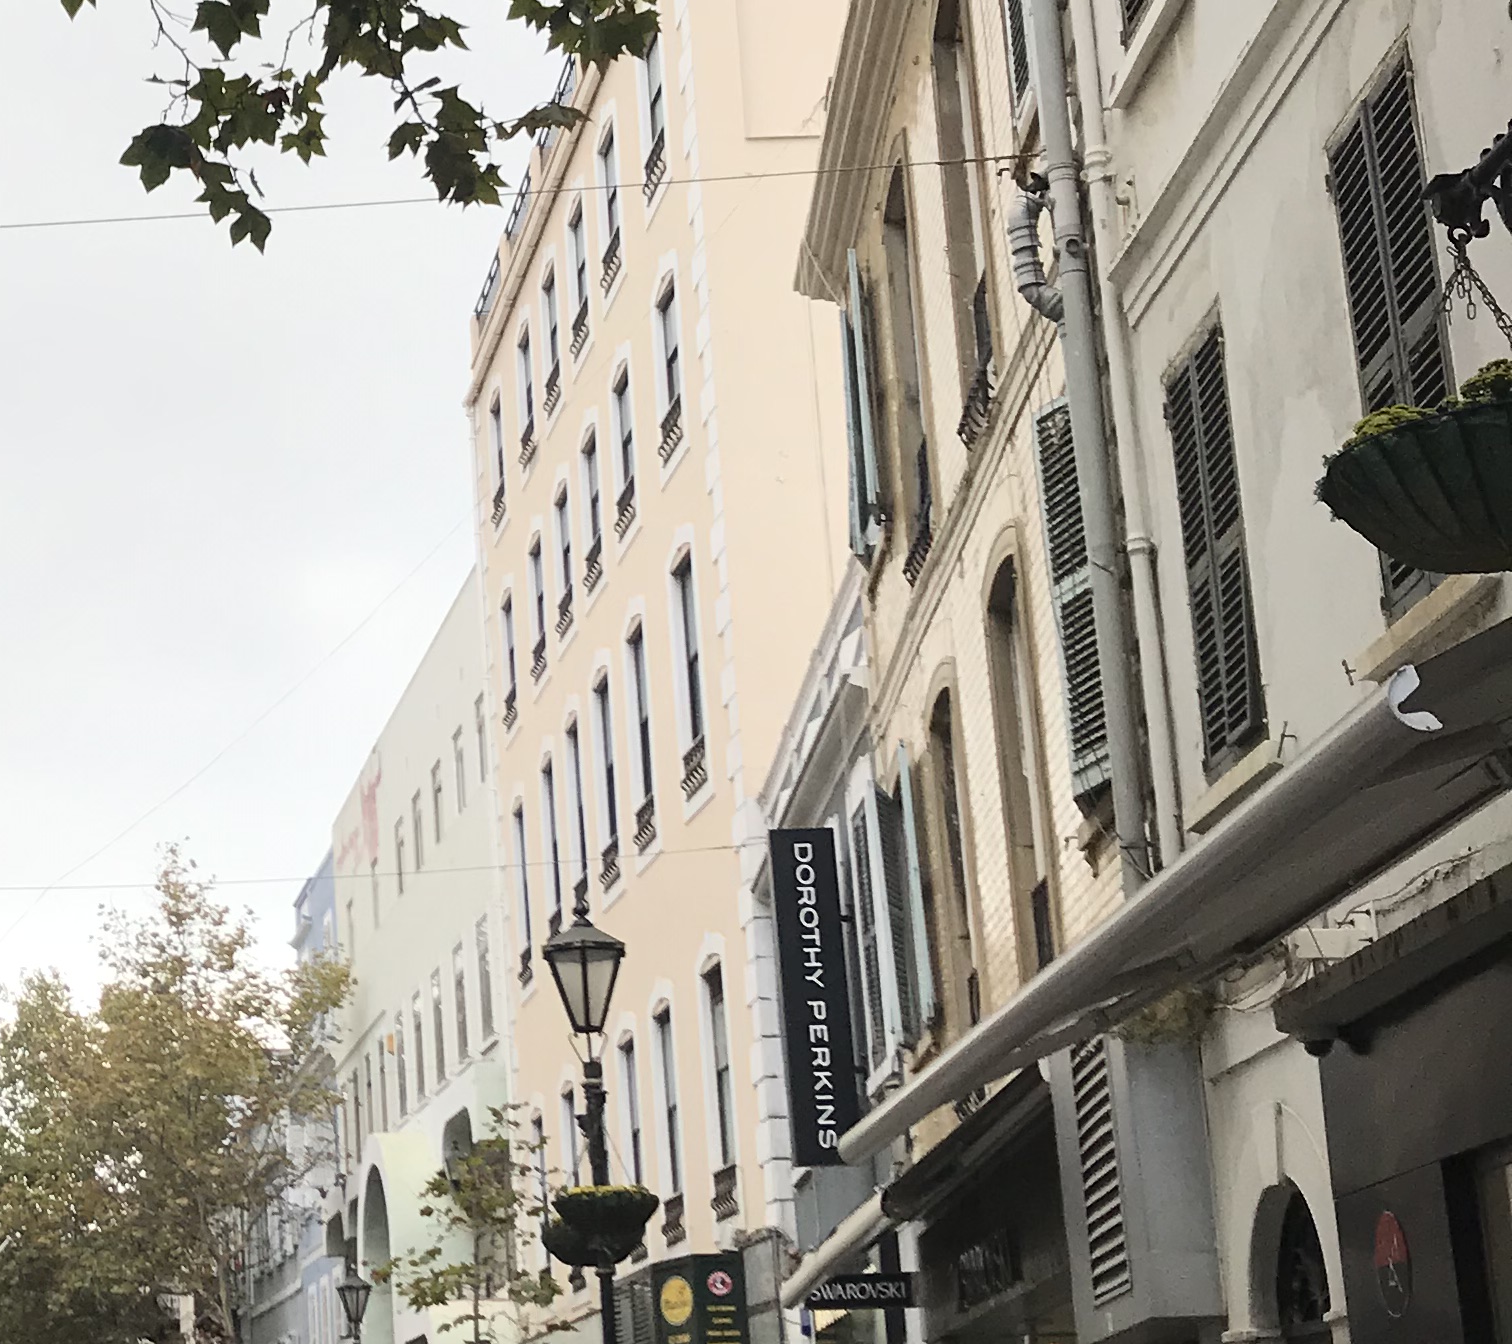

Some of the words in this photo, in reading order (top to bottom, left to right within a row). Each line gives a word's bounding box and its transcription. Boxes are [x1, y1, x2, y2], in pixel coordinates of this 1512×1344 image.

[793, 842, 825, 988] DOROTHY
[807, 999, 838, 1150] PERKINS
[810, 1282, 906, 1302] SWAROVSKI
